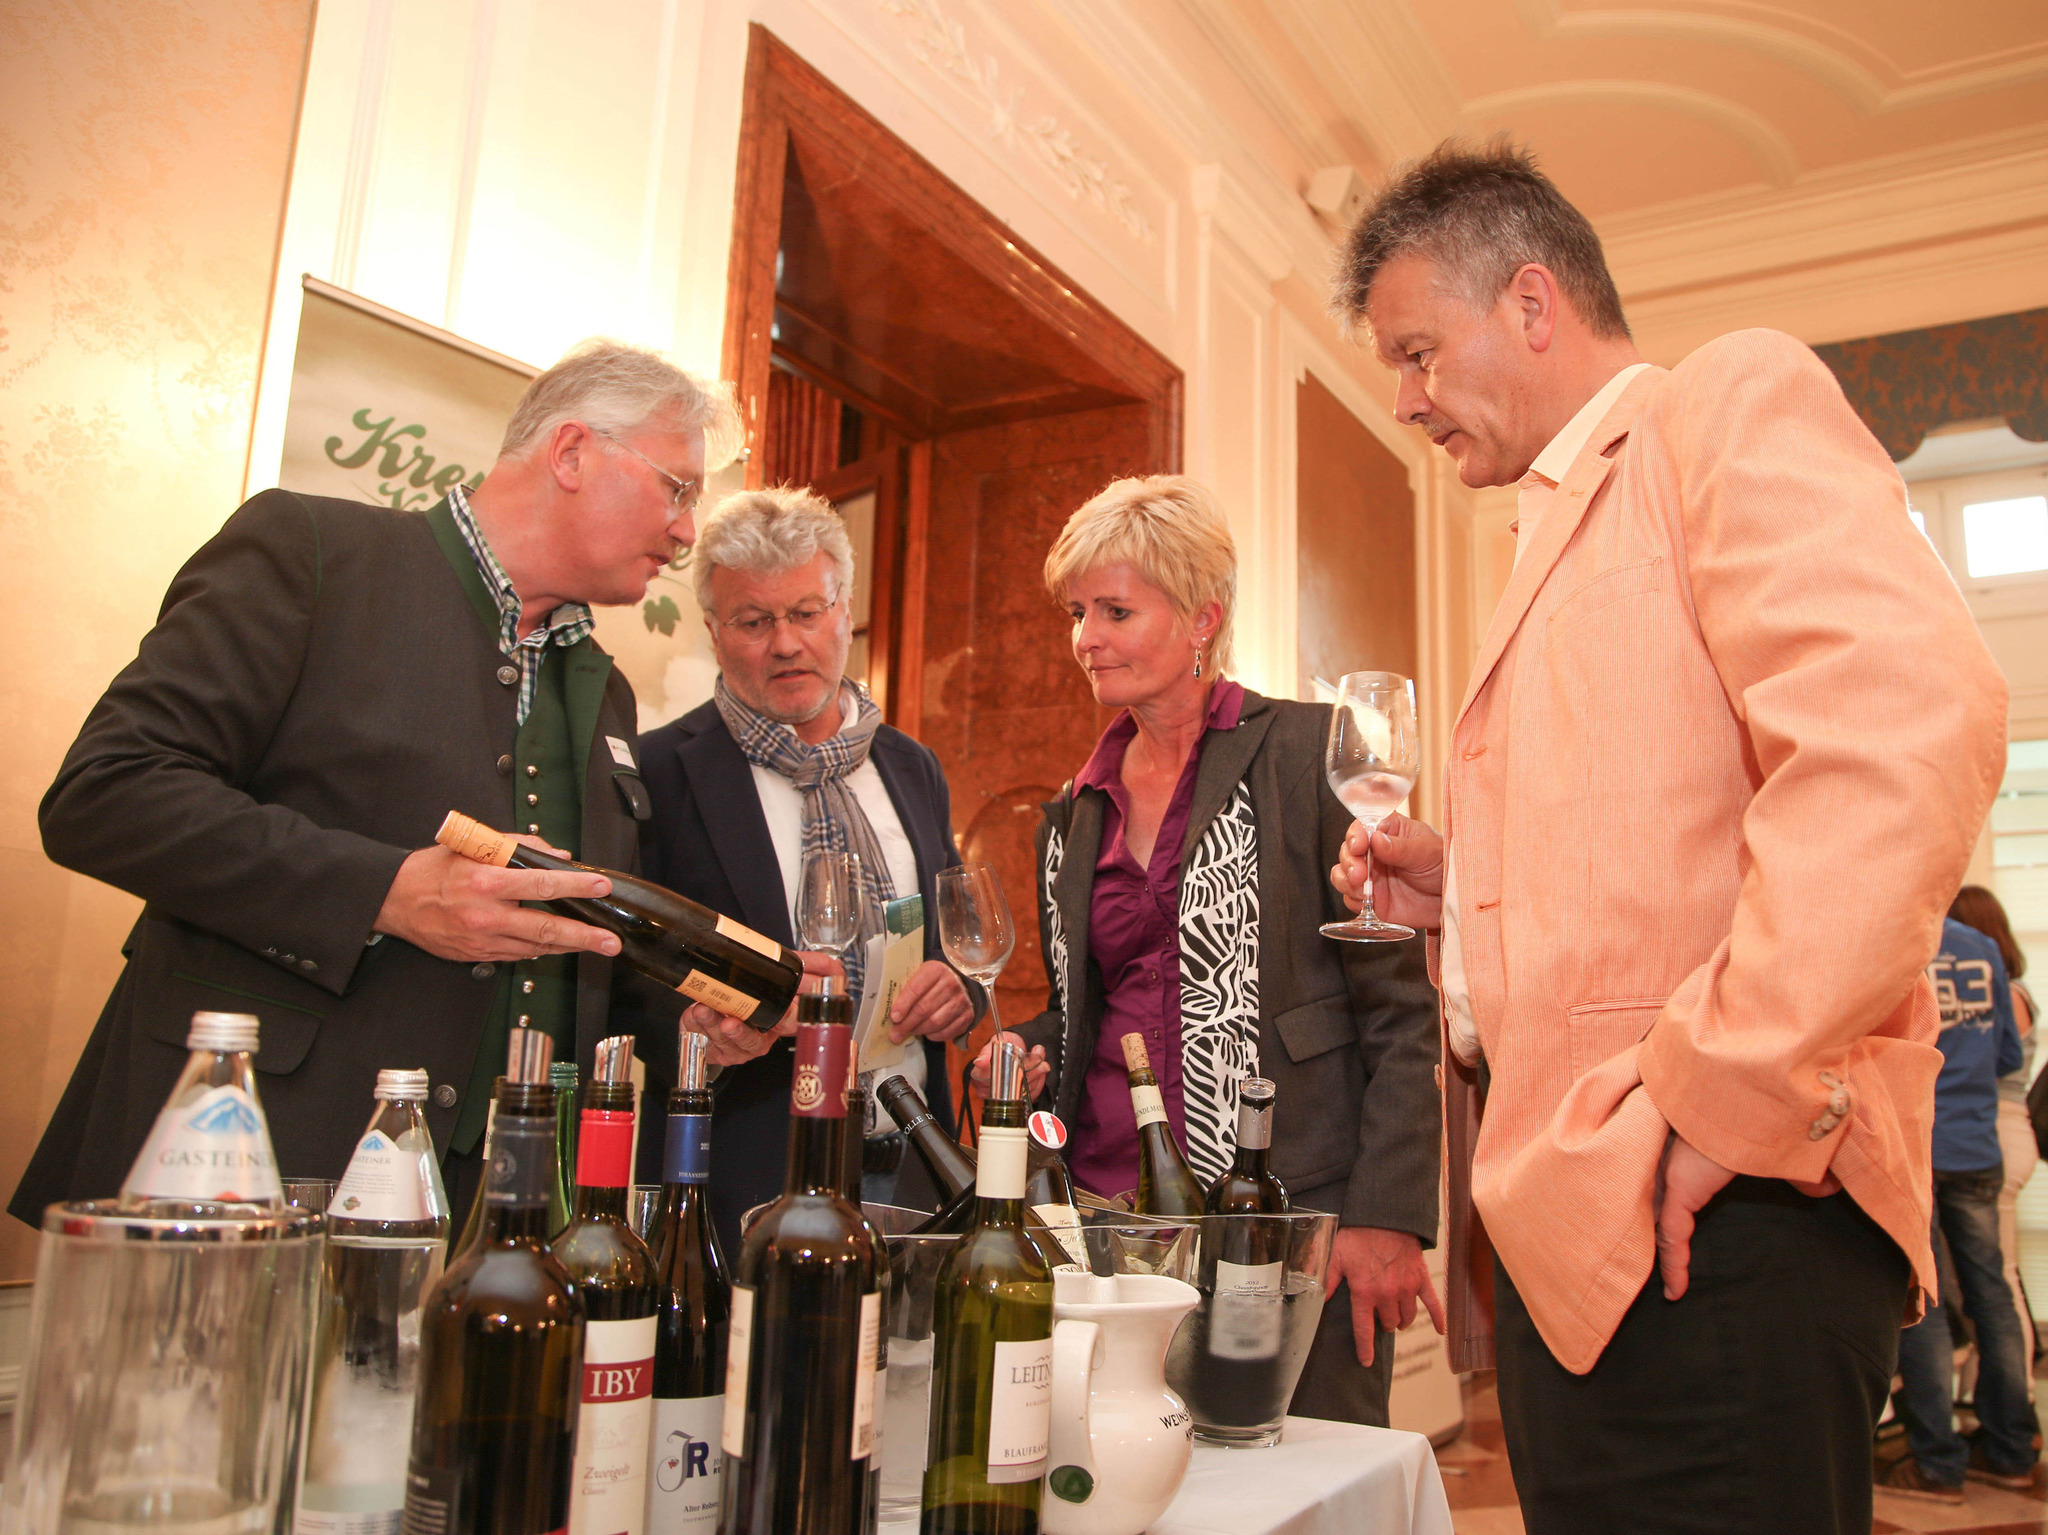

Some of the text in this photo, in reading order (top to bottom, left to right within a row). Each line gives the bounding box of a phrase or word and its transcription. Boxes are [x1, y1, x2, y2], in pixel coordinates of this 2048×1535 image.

[904, 1115, 924, 1135] OLLE
[589, 1367, 643, 1397] IBY
[1011, 1363, 1052, 1385] LEITN
[683, 1505, 700, 1513] Alter
